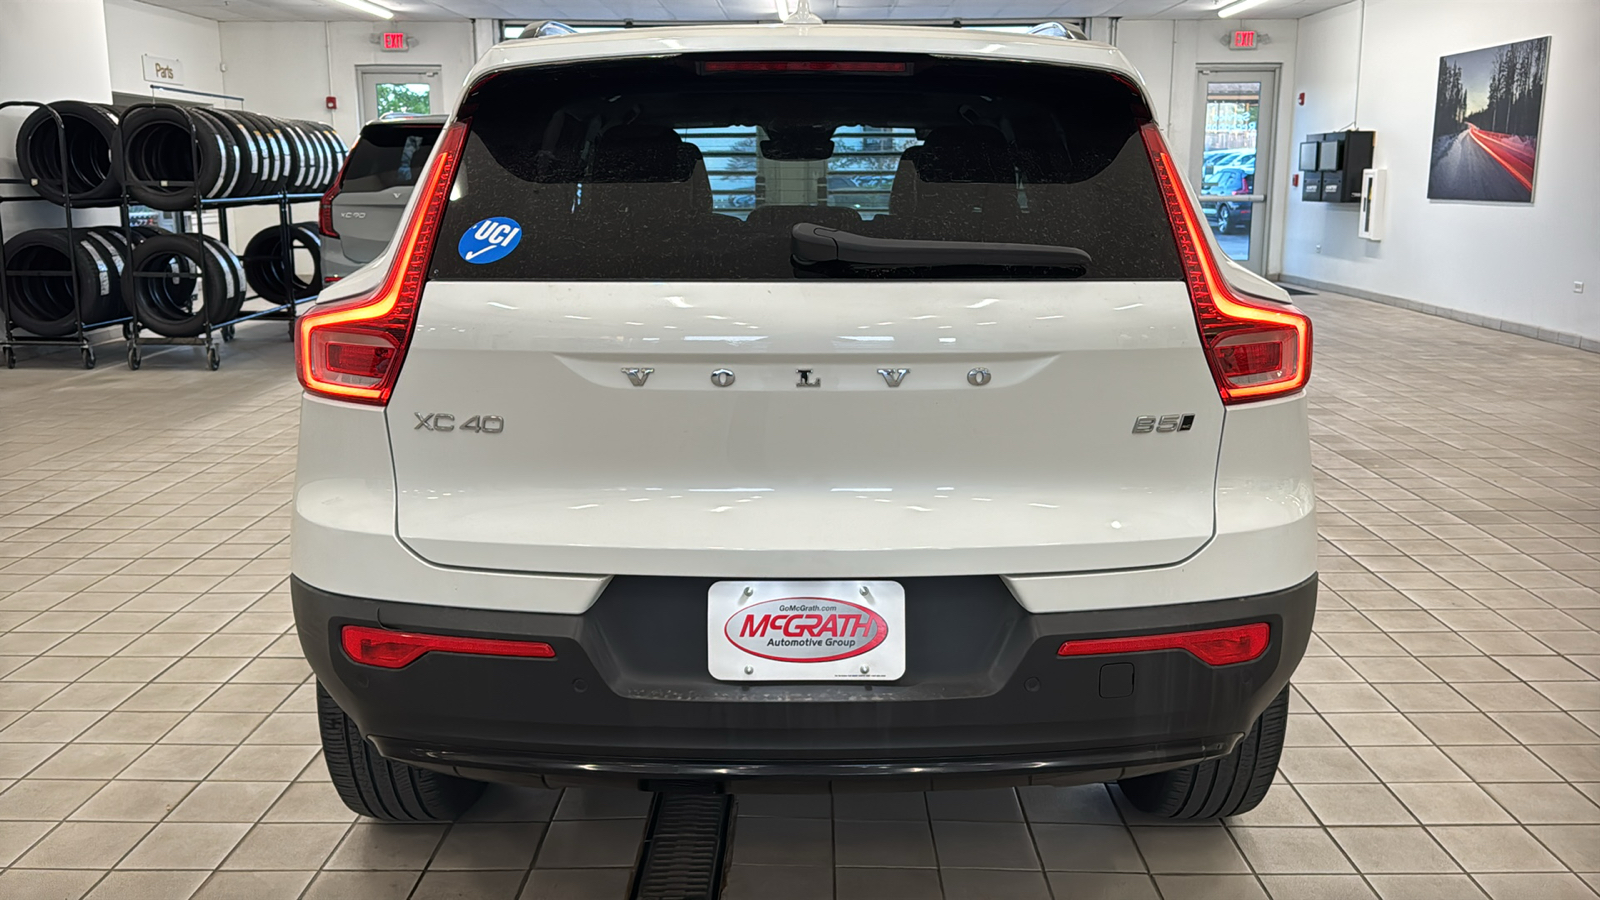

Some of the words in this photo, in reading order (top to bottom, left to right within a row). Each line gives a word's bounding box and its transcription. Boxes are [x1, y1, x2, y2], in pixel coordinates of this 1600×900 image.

[384, 32, 404, 49] EXIT
[1235, 30, 1255, 47] EXIT
[155, 62, 174, 79] Parts
[474, 219, 521, 248] UCI
[620, 366, 992, 389] VOLVO
[779, 604, 837, 612] GoMcGrath.com
[766, 637, 823, 648] Automotive
[825, 637, 856, 649] Group
